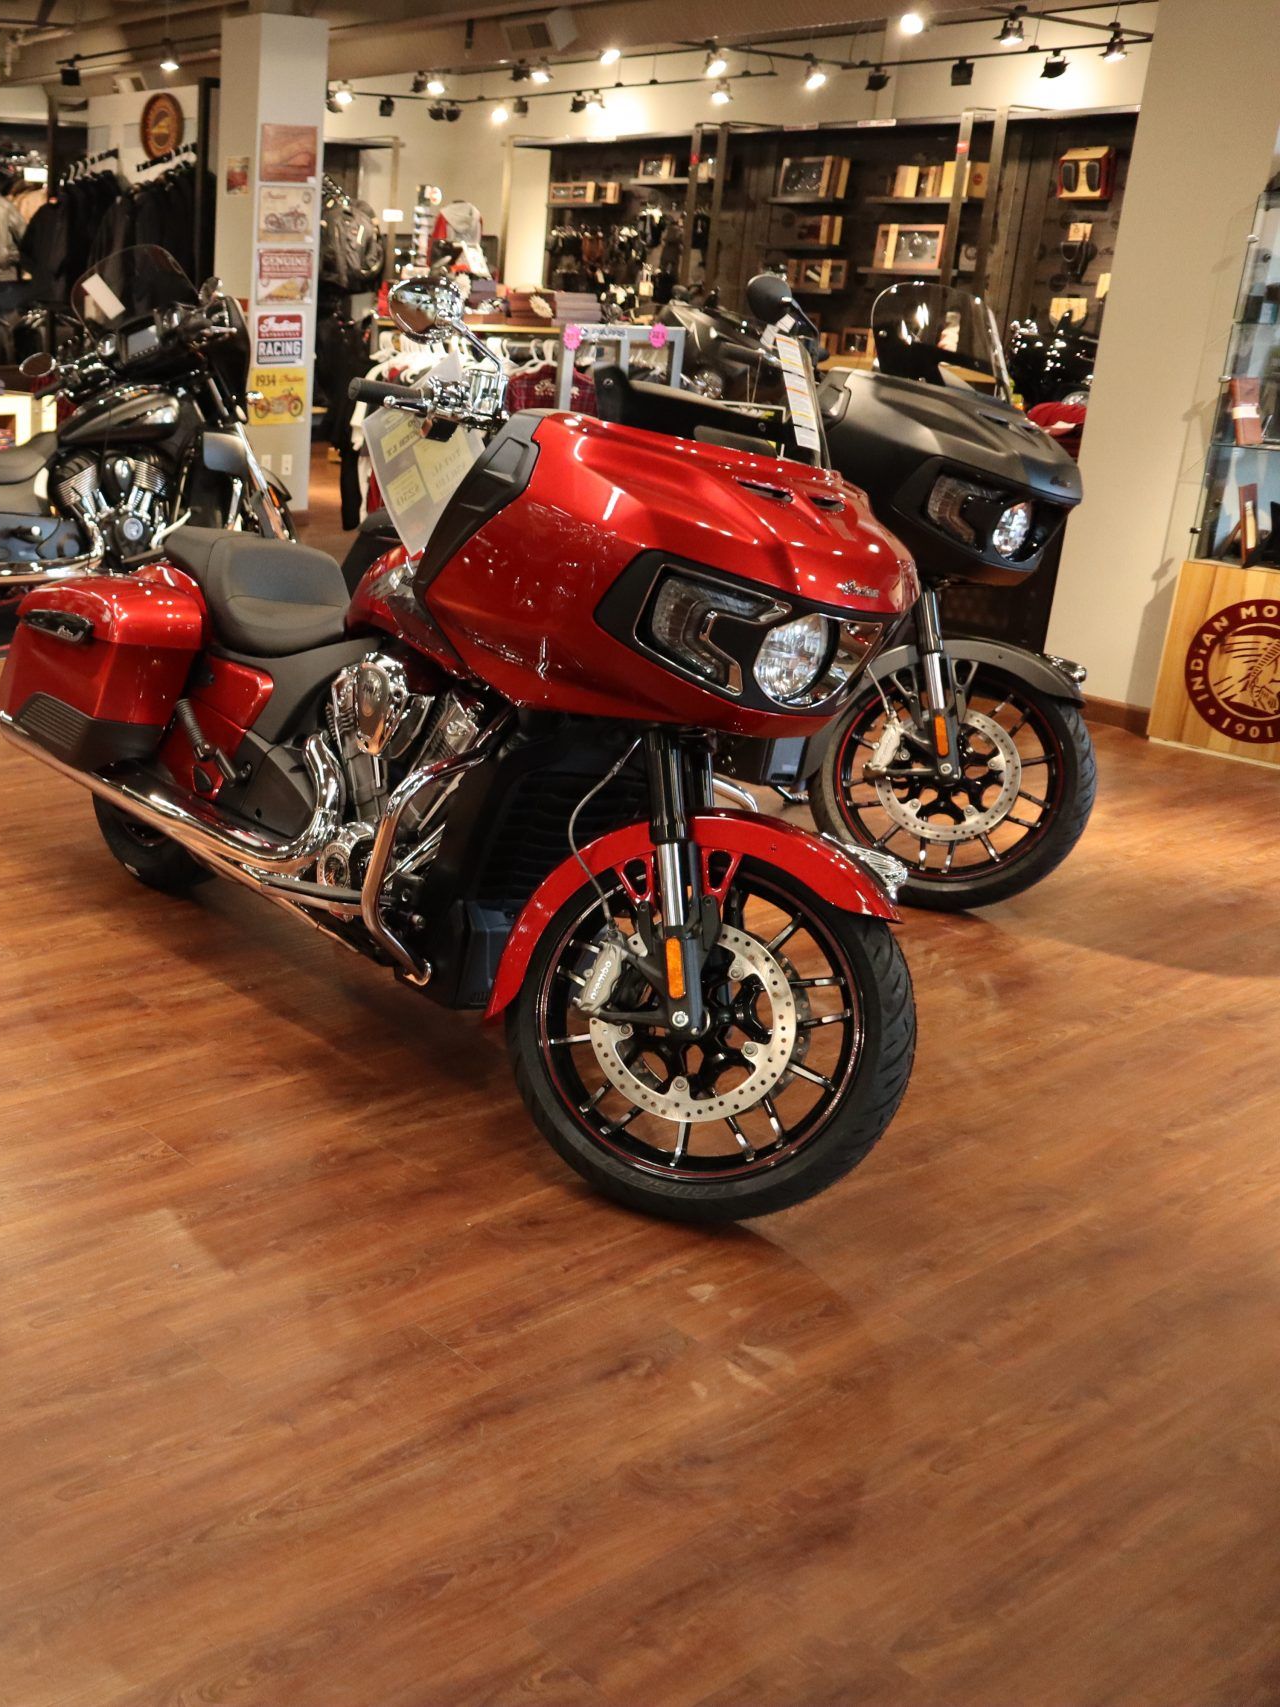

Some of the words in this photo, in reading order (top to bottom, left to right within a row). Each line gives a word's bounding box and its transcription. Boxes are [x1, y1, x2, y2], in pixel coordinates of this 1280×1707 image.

[261, 255, 309, 267] GENUINE
[258, 316, 303, 333] Indian
[257, 340, 302, 355] RACING
[256, 374, 277, 387] 1934
[836, 579, 880, 599] Indian
[1190, 615, 1229, 702] INDIAN
[1221, 717, 1274, 739] 1901
